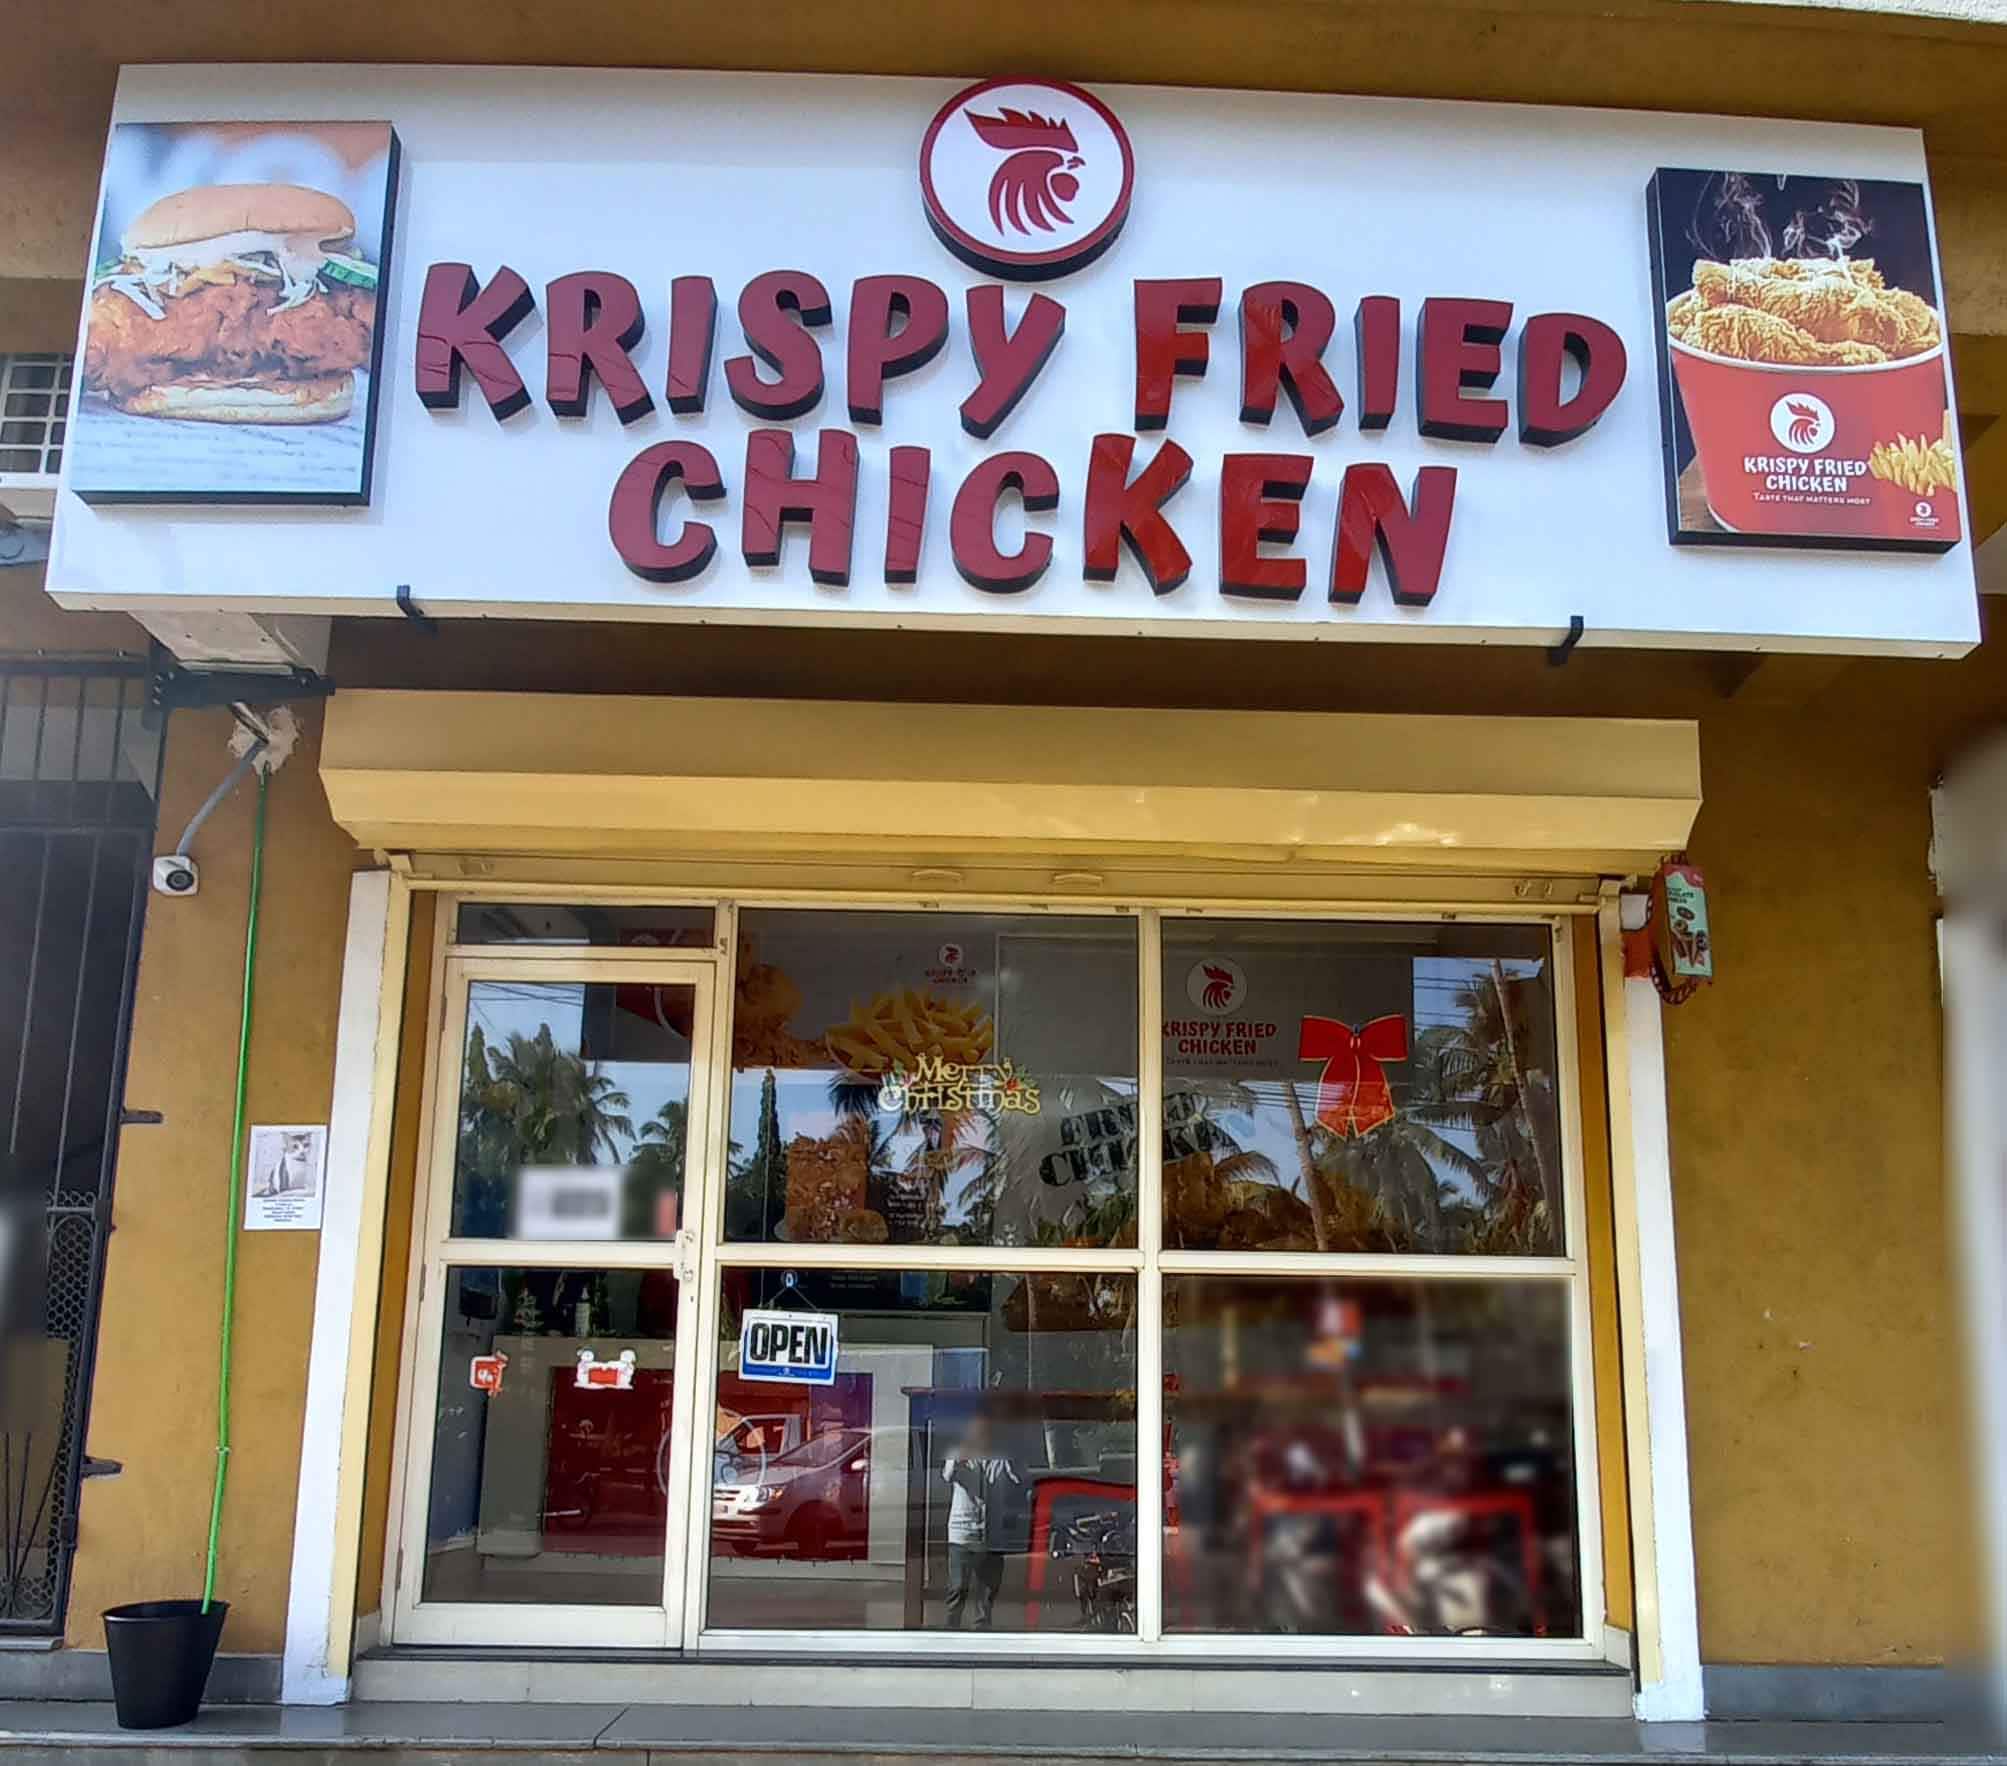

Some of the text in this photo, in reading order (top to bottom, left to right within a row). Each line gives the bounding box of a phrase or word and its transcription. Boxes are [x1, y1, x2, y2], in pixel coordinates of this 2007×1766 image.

[415, 263, 1627, 448] KRISPY FRIED
[1743, 456, 1867, 476] KRISPY FRIED
[1765, 475, 1848, 492] CHICKEN
[609, 429, 1458, 608] CHICKEN
[1225, 1021, 1278, 1039] FRIED
[1178, 1039, 1257, 1056] CHICKEN
[913, 1052, 1013, 1085] Merry
[877, 1080, 1041, 1117] Christmas
[750, 1323, 828, 1365] OPEN
